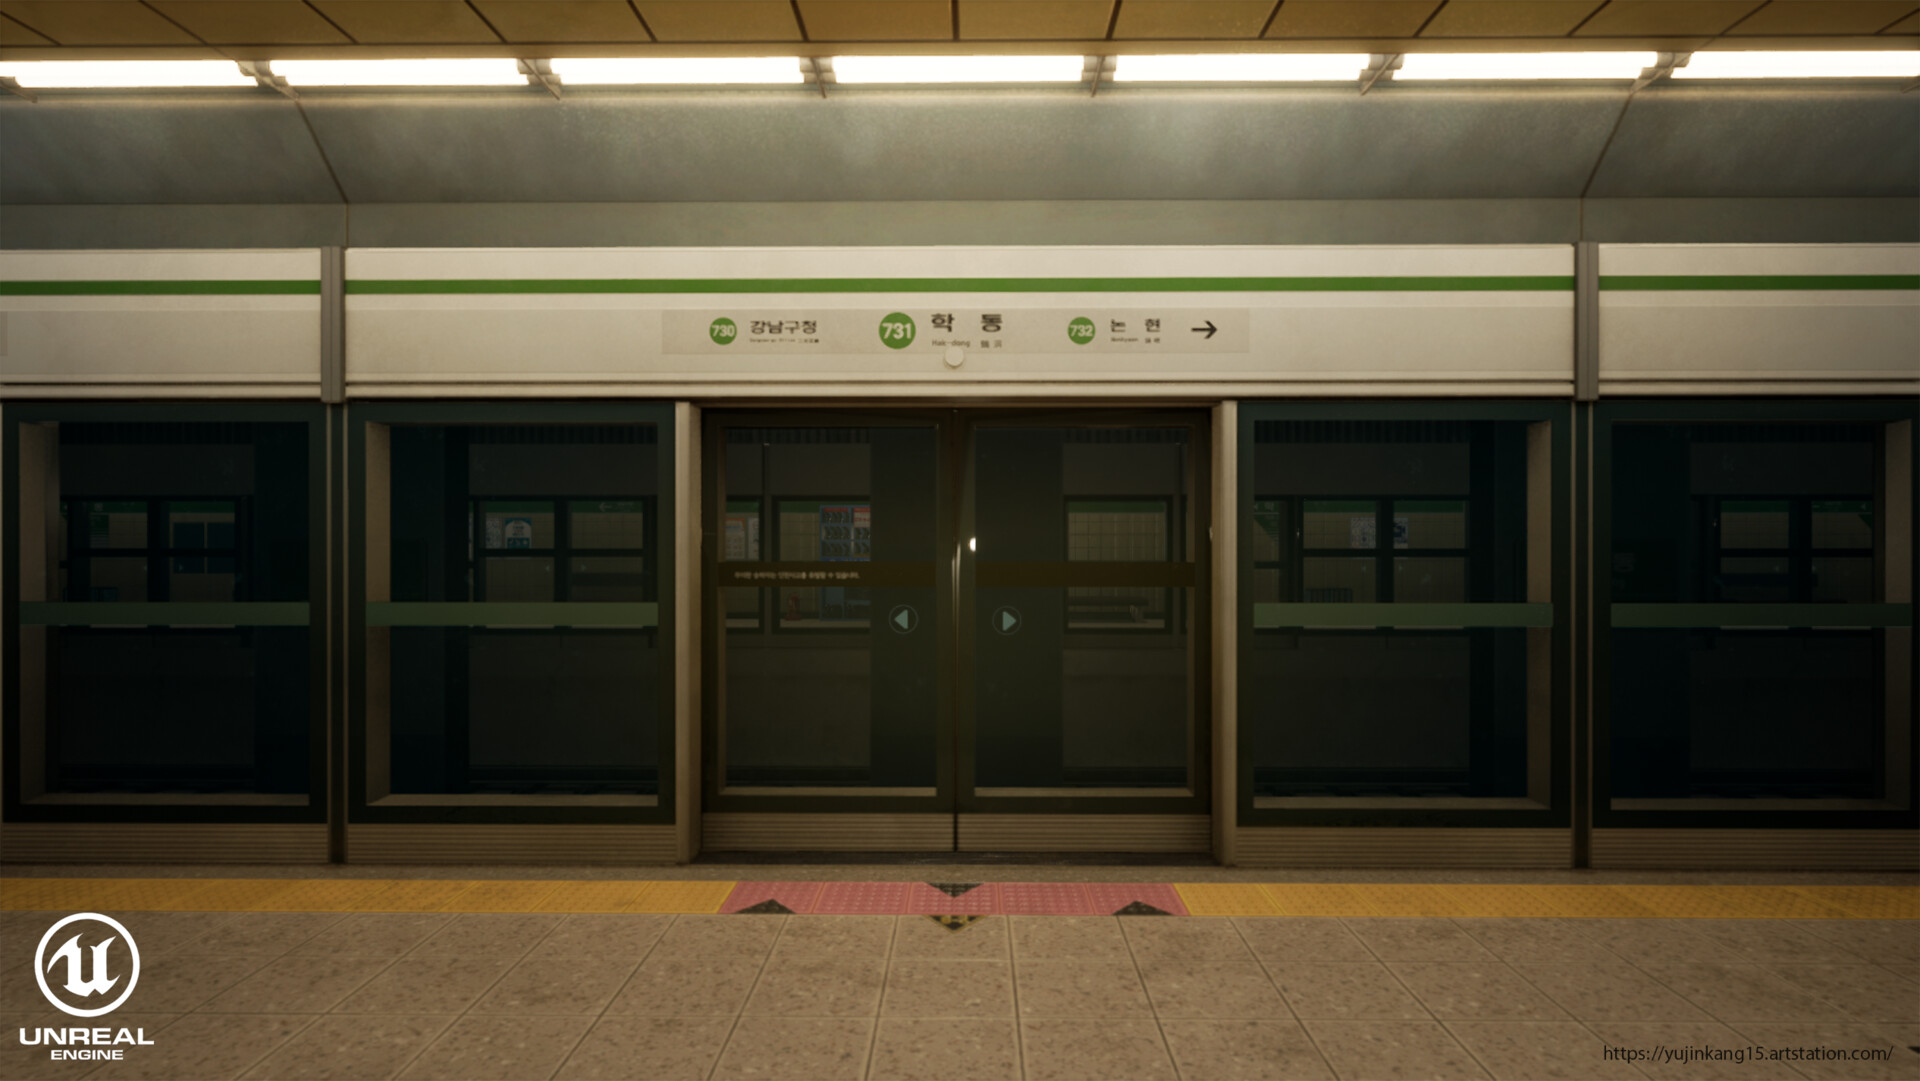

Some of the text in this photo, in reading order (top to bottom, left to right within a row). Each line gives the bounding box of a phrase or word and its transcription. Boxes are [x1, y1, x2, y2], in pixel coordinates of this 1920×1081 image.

[711, 325, 735, 337] 730
[882, 323, 912, 339] 731
[931, 313, 955, 333] 학
[1069, 325, 1094, 337] 732
